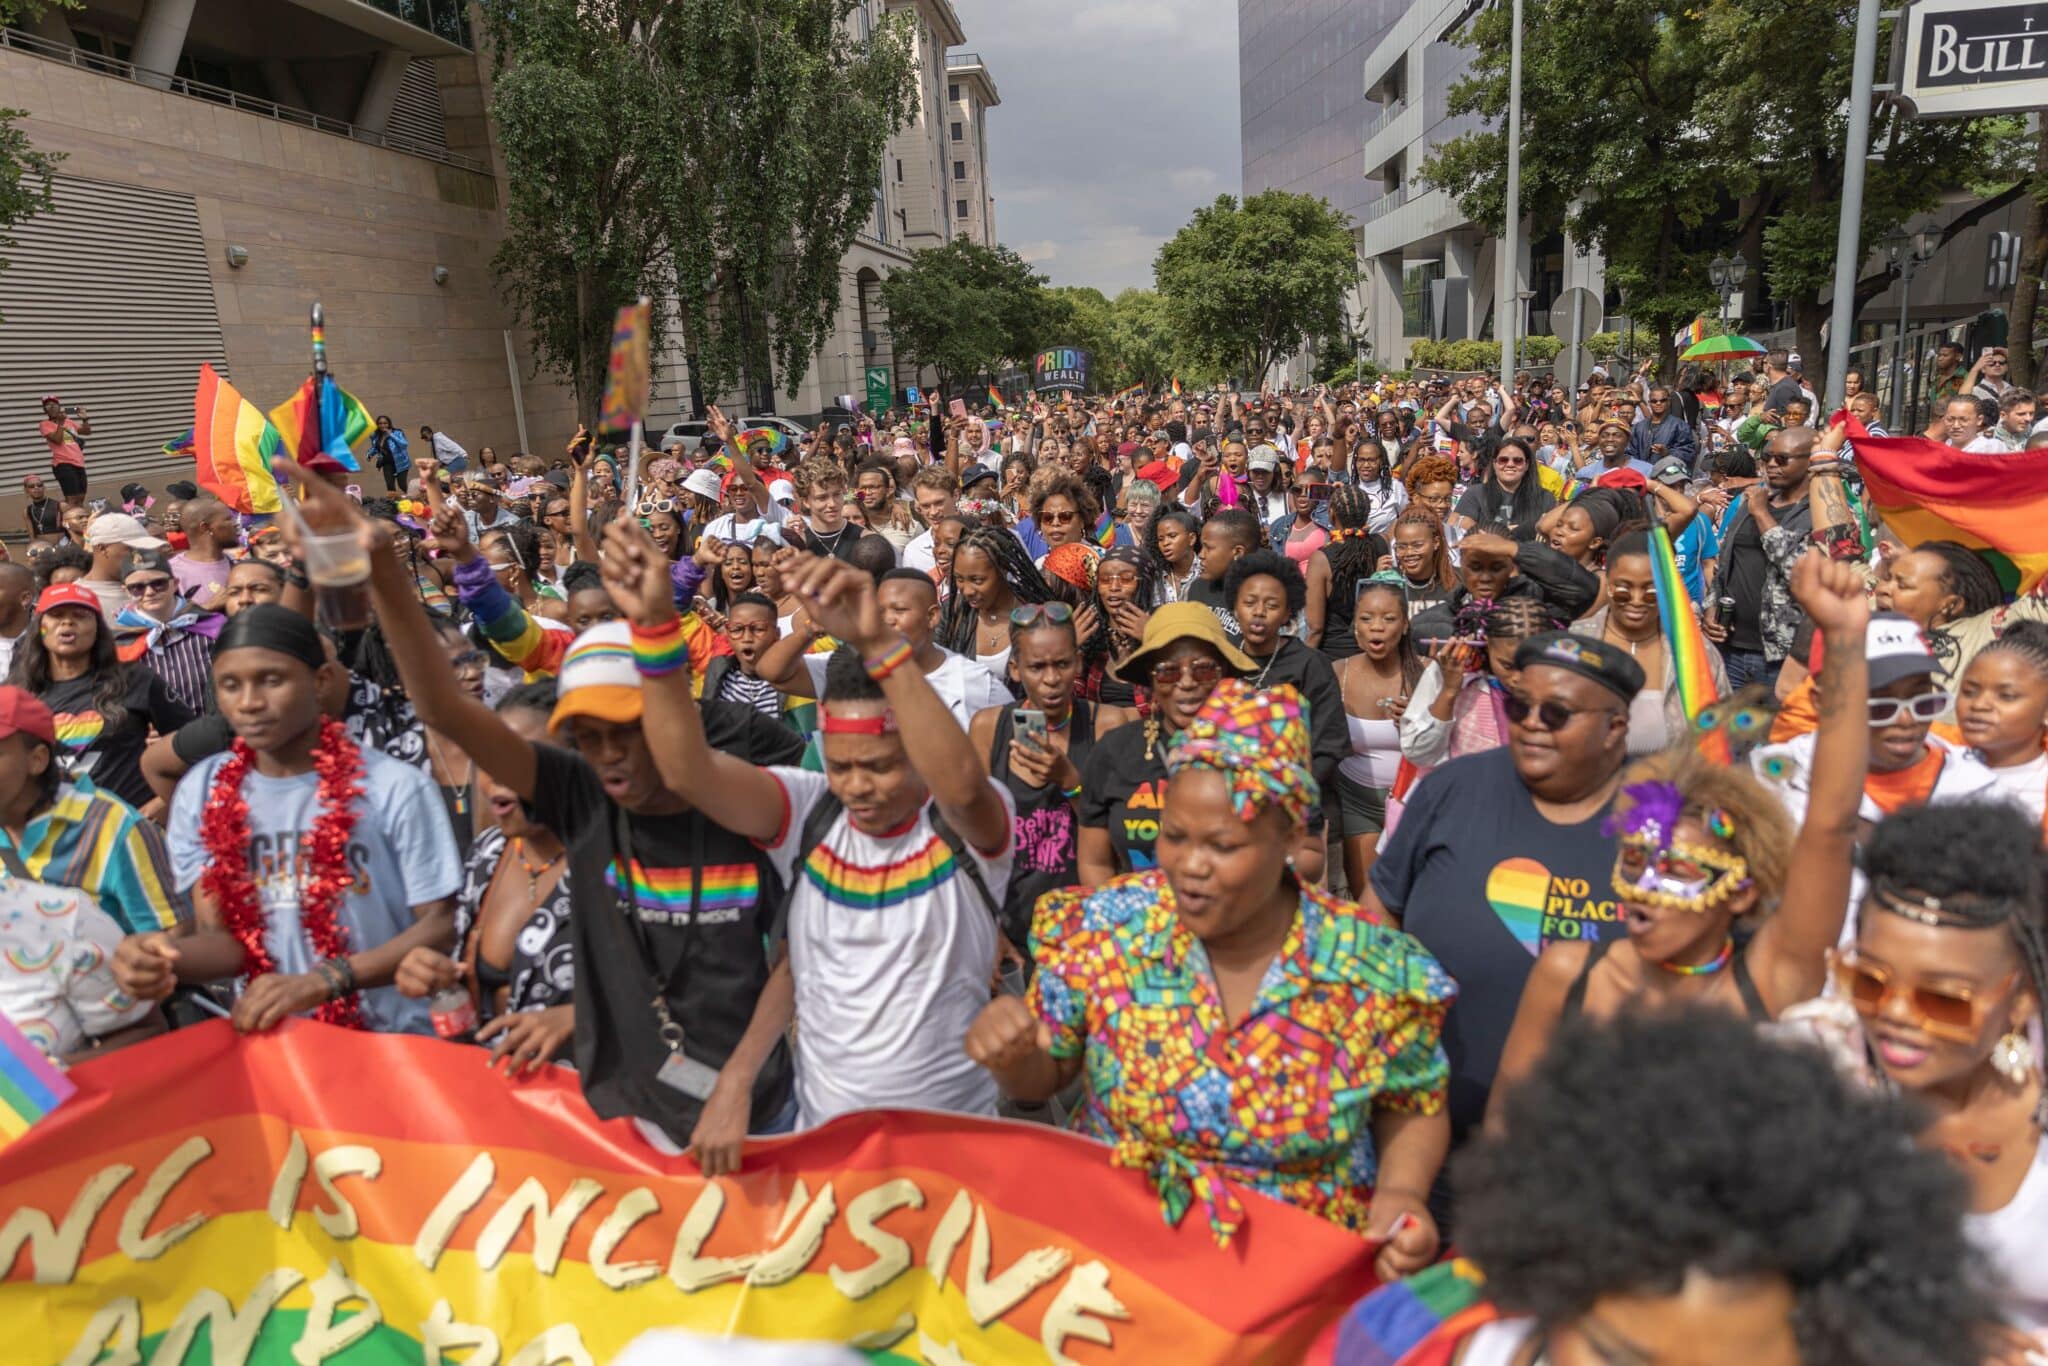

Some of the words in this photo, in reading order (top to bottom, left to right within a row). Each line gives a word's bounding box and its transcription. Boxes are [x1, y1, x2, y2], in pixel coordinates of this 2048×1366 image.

[1928, 24, 2046, 77] BULL
[1036, 349, 1086, 375] PRIDE
[1044, 370, 1085, 384] WEALTH
[1124, 819, 1162, 841] YO
[1551, 876, 1590, 898] NO
[1542, 916, 1599, 941] FOR
[268, 1129, 381, 1240] IS
[414, 1151, 1131, 1366] INCLUSIVE
